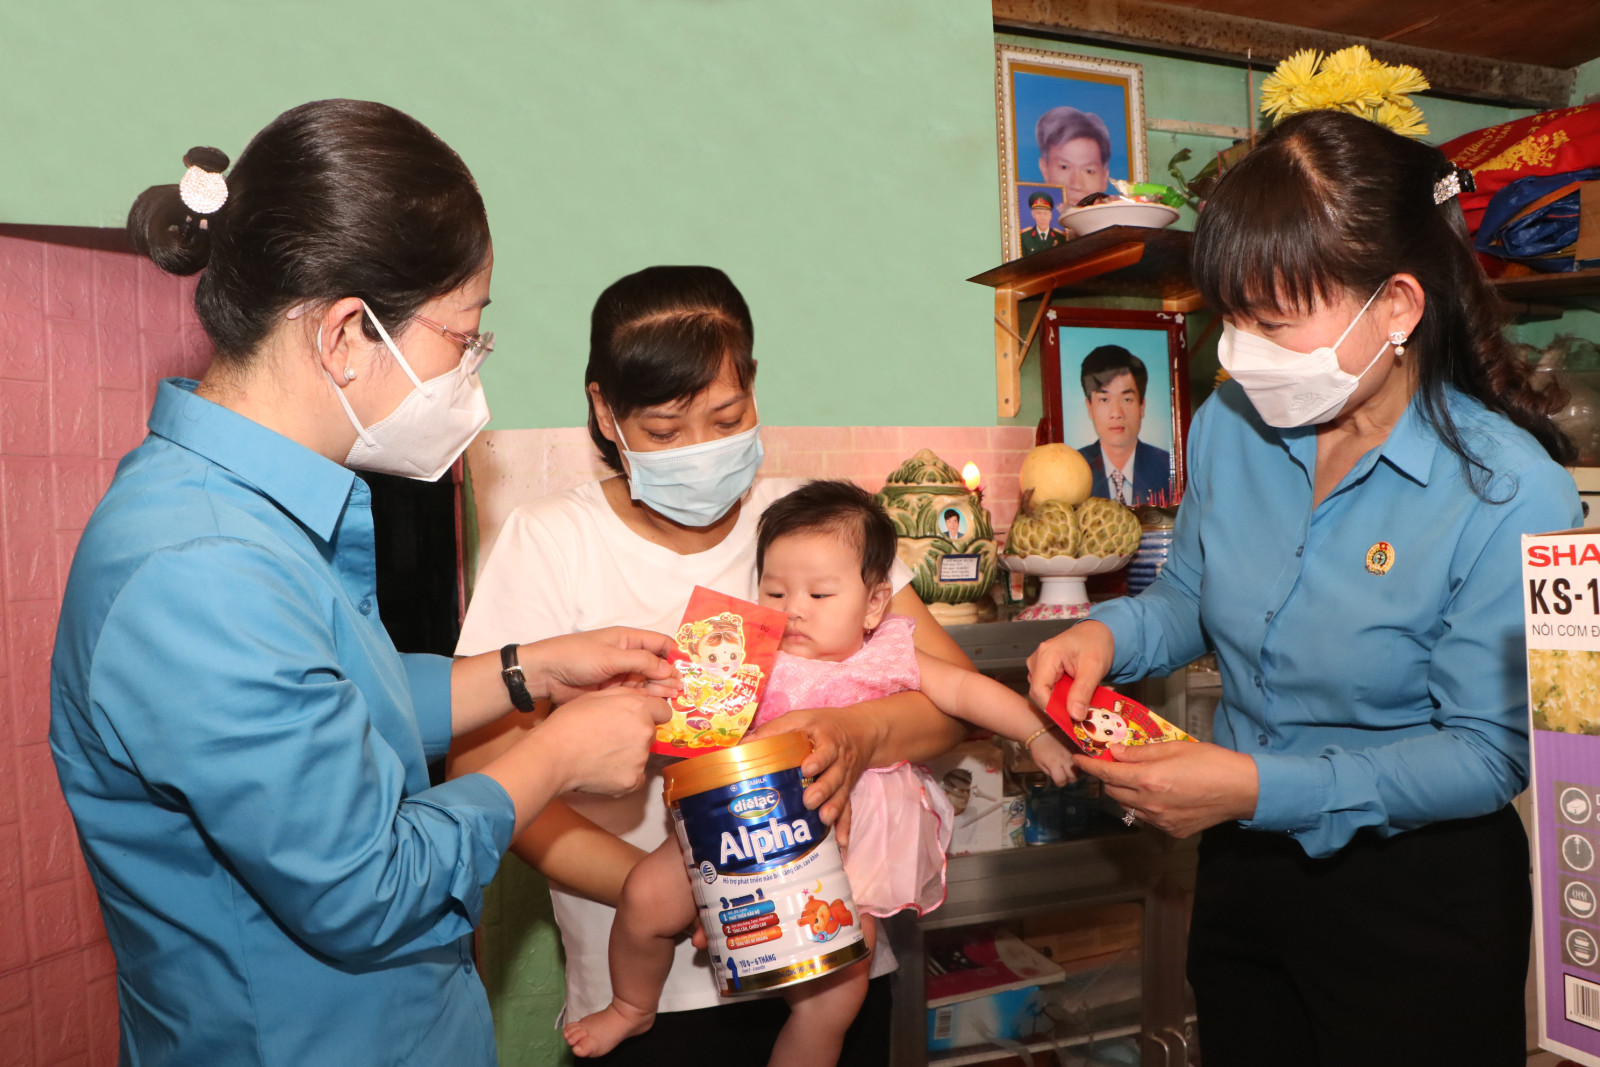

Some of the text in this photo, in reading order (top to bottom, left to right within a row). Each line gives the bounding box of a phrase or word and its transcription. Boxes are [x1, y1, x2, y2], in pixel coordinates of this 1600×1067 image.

[1527, 543, 1600, 567] SHA
[1529, 577, 1600, 615] KS-1
[1557, 624, 1588, 637] CƠM
[720, 817, 813, 865] Alpha
